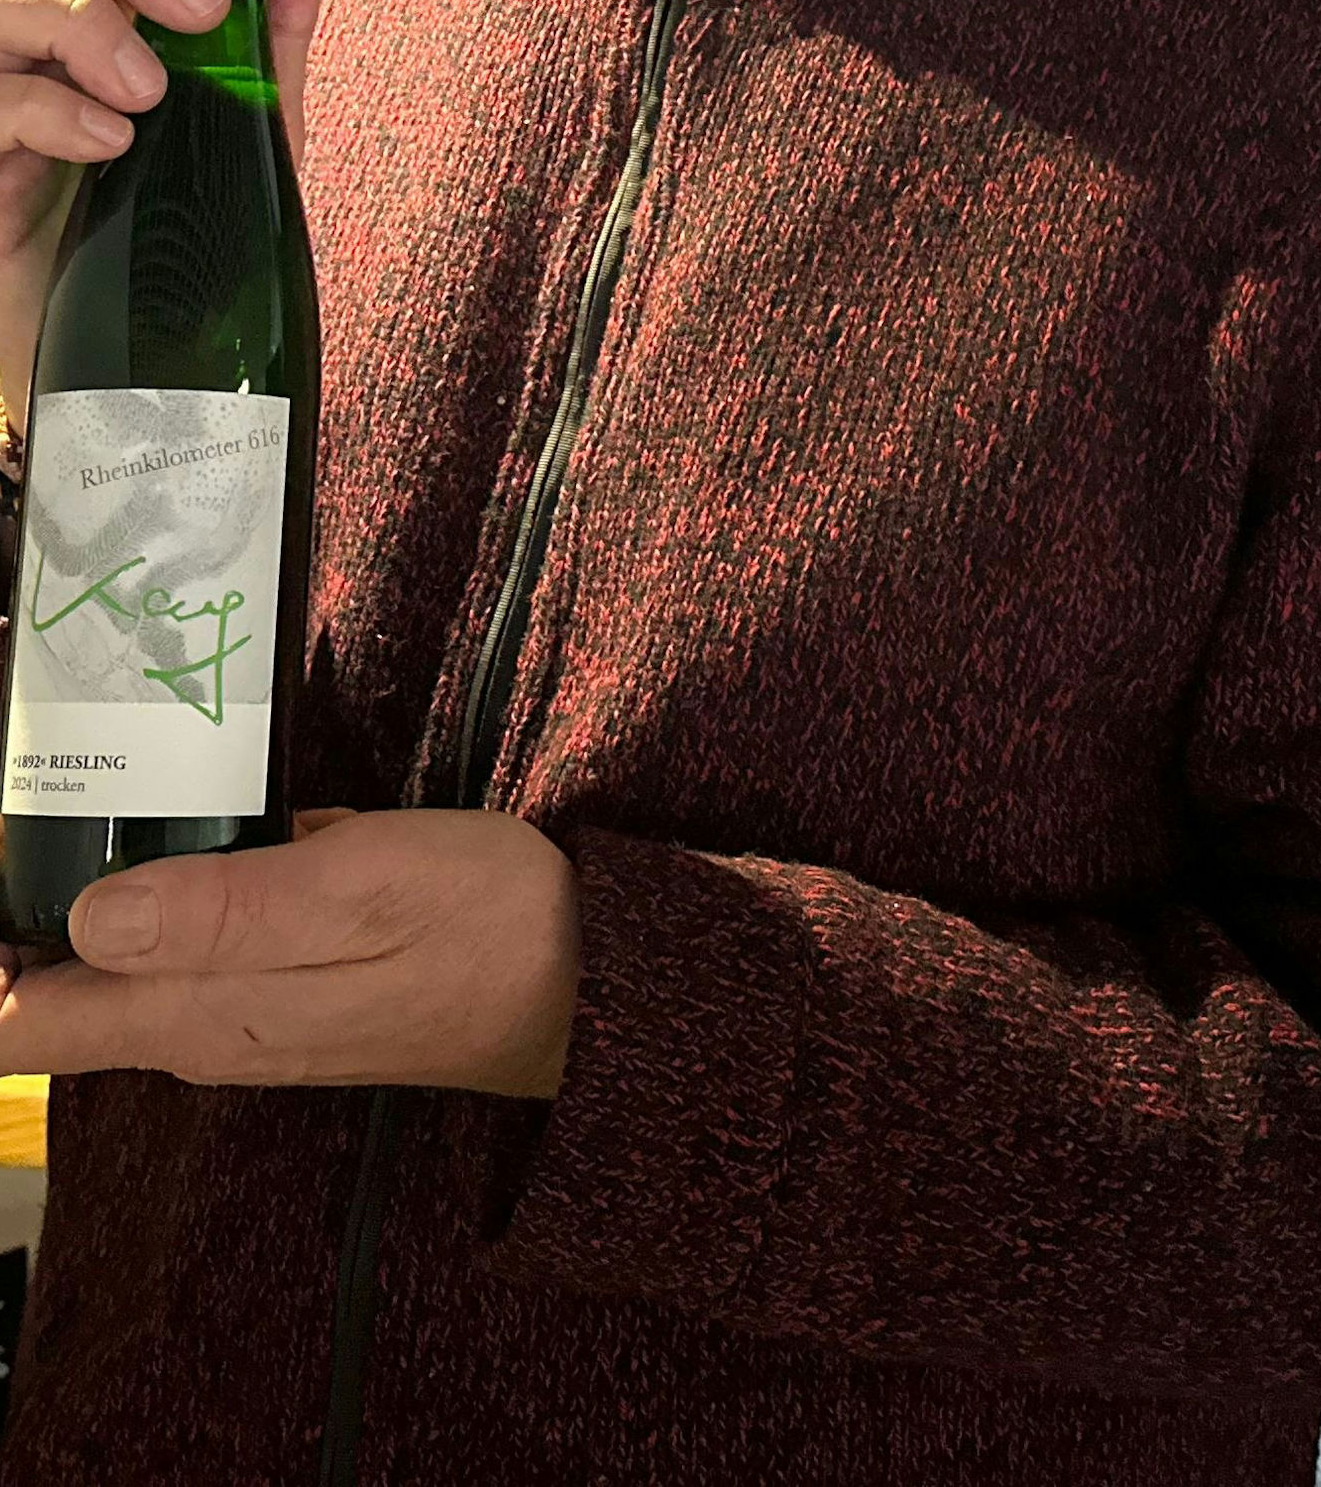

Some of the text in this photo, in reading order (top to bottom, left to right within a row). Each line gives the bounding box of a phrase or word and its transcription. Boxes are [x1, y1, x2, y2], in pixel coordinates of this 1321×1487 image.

[80, 424, 281, 491] Rheinkilometer 616
[49, 754, 126, 770] RIESLING
[41, 776, 86, 792] trocken
